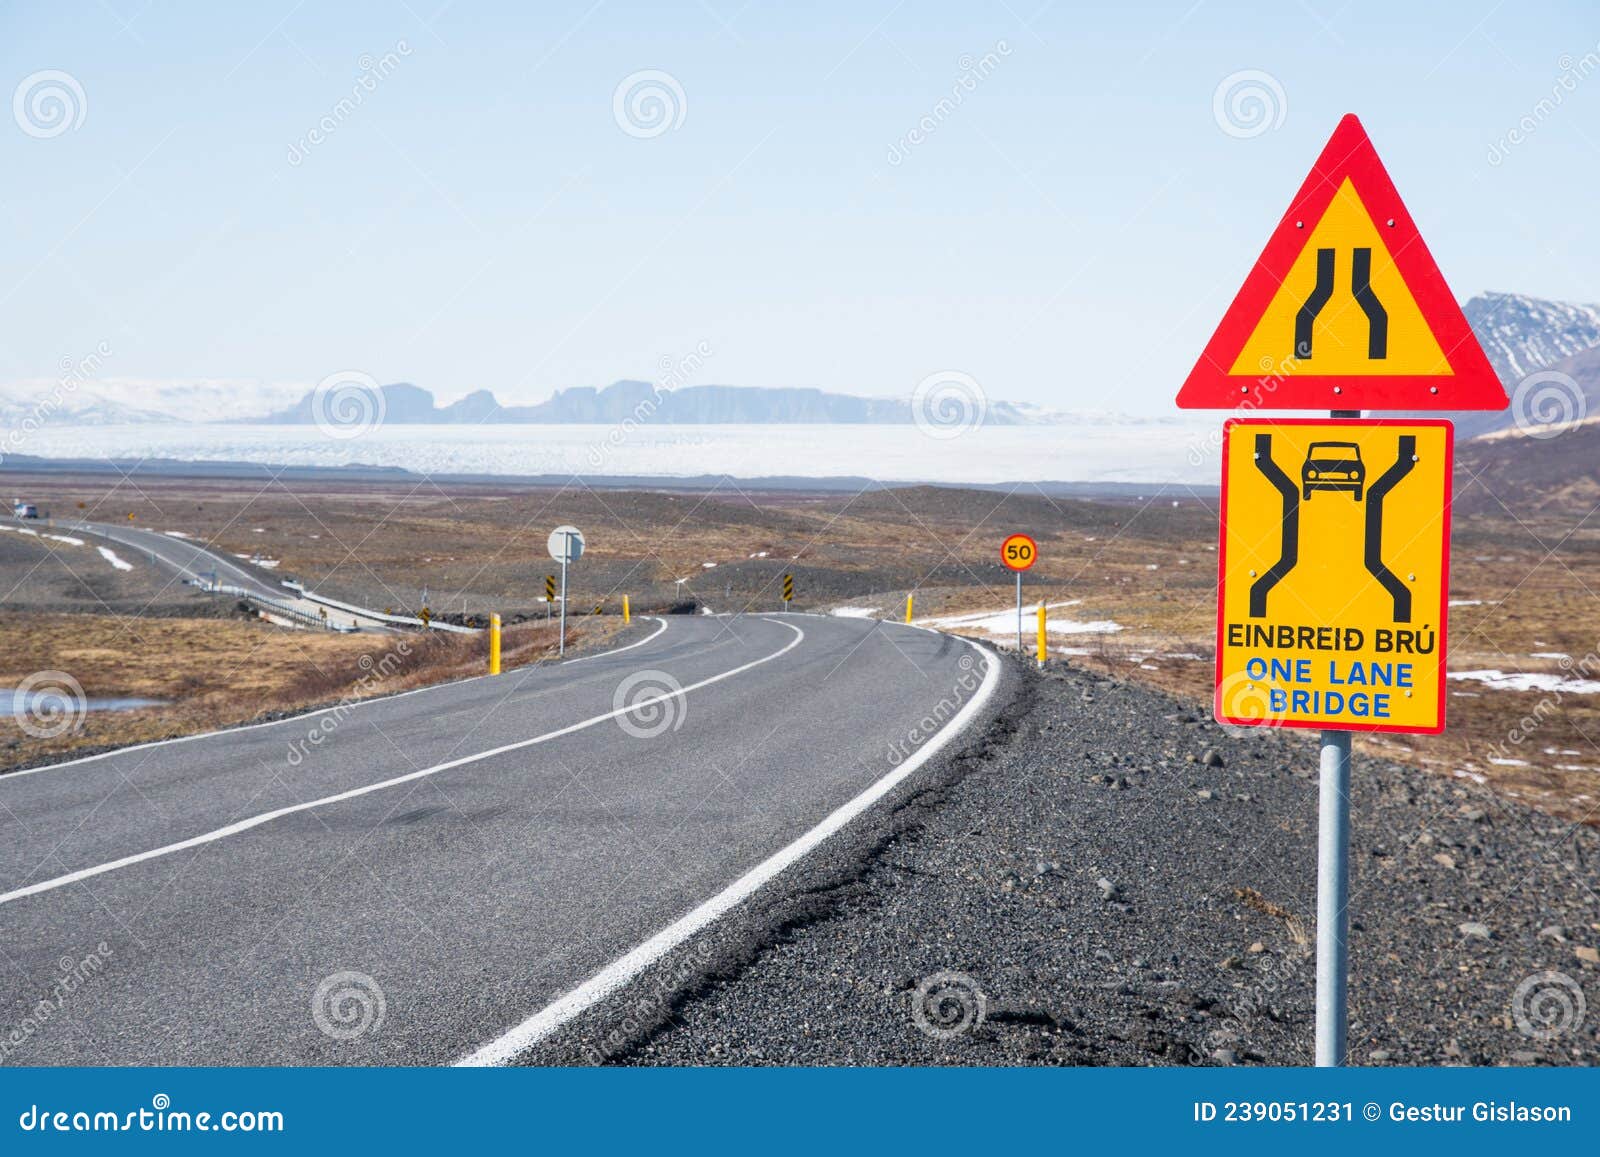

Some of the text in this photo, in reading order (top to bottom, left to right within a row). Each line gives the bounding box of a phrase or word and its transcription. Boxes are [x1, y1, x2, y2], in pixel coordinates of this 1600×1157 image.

[1007, 545, 1031, 560] 50
[1227, 623, 1435, 655] EINBREIÐ BRÚ
[1246, 657, 1413, 688] ONE LANE
[1269, 688, 1391, 718] BRIDGE
